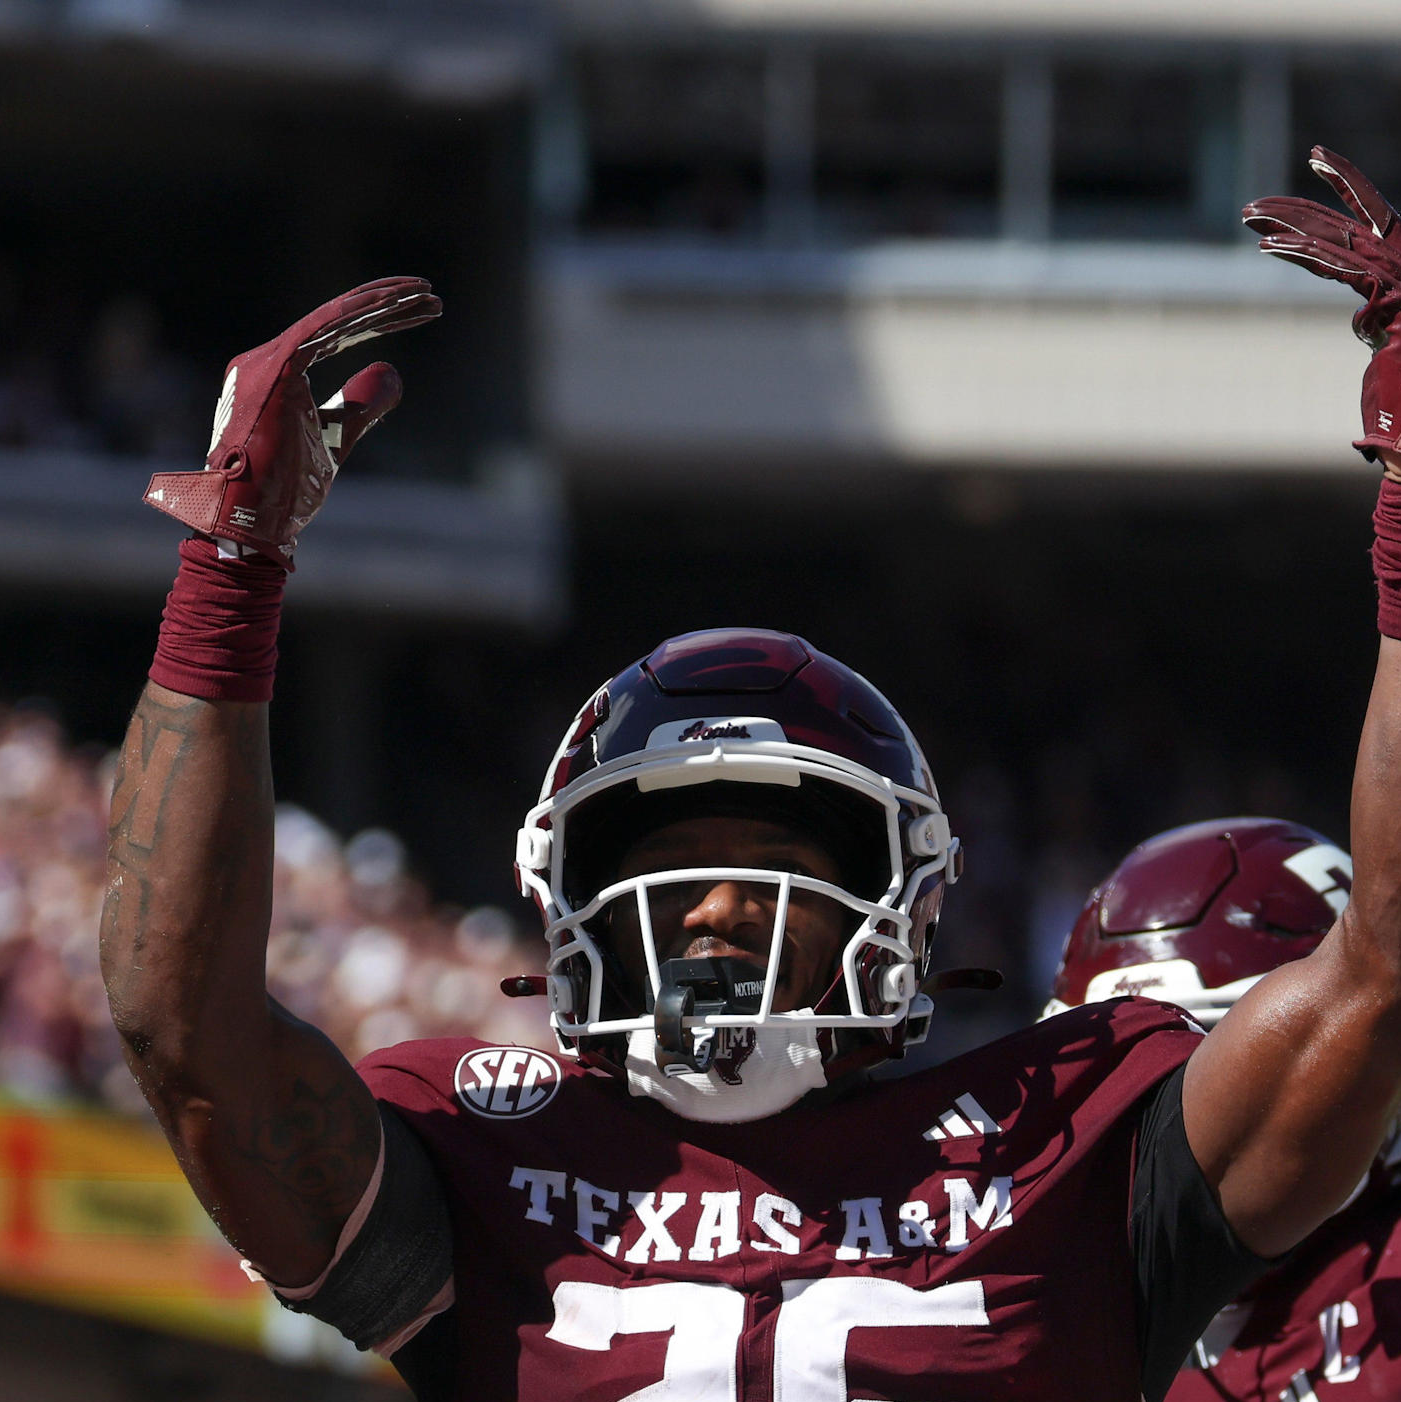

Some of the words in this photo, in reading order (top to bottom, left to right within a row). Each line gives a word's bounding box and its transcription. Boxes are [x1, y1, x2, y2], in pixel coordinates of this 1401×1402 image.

[464, 1050, 553, 1113] SEC
[509, 1166, 801, 1263] TEXAS
[836, 1175, 1013, 1261] A&M
[1318, 1300, 1361, 1384] C
